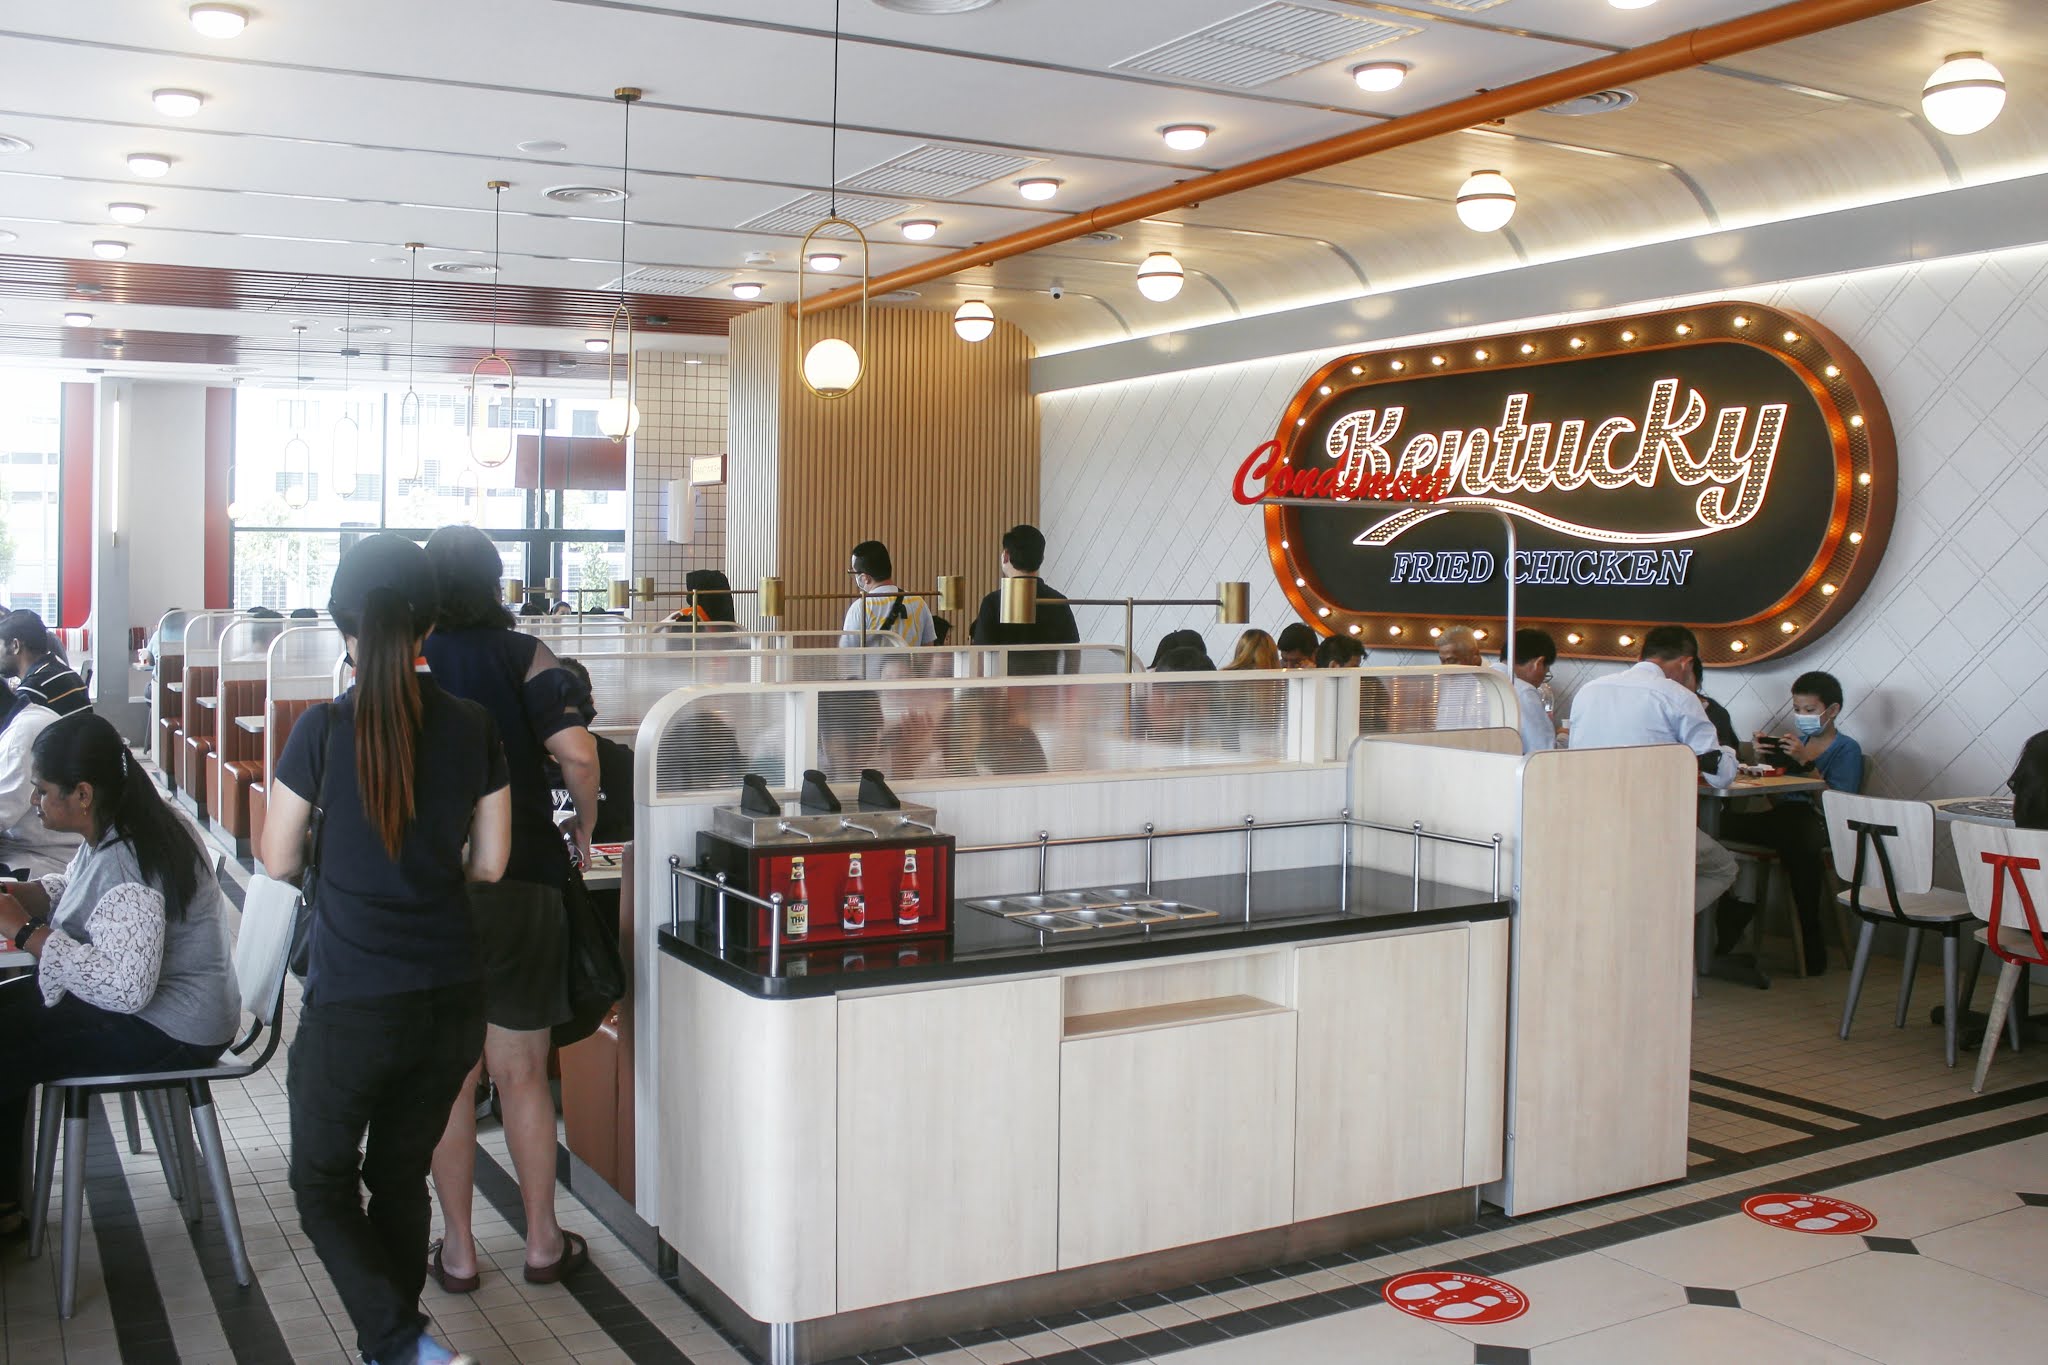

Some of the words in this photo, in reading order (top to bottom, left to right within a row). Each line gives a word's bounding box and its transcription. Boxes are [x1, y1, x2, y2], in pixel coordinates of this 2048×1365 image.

[1326, 378, 1788, 528] Kentucky
[1390, 552, 1495, 584] FRIED
[1504, 549, 1693, 586] CHICKEN
[1452, 1274, 1491, 1286] HERE
[1490, 1284, 1519, 1304] QUEUE
